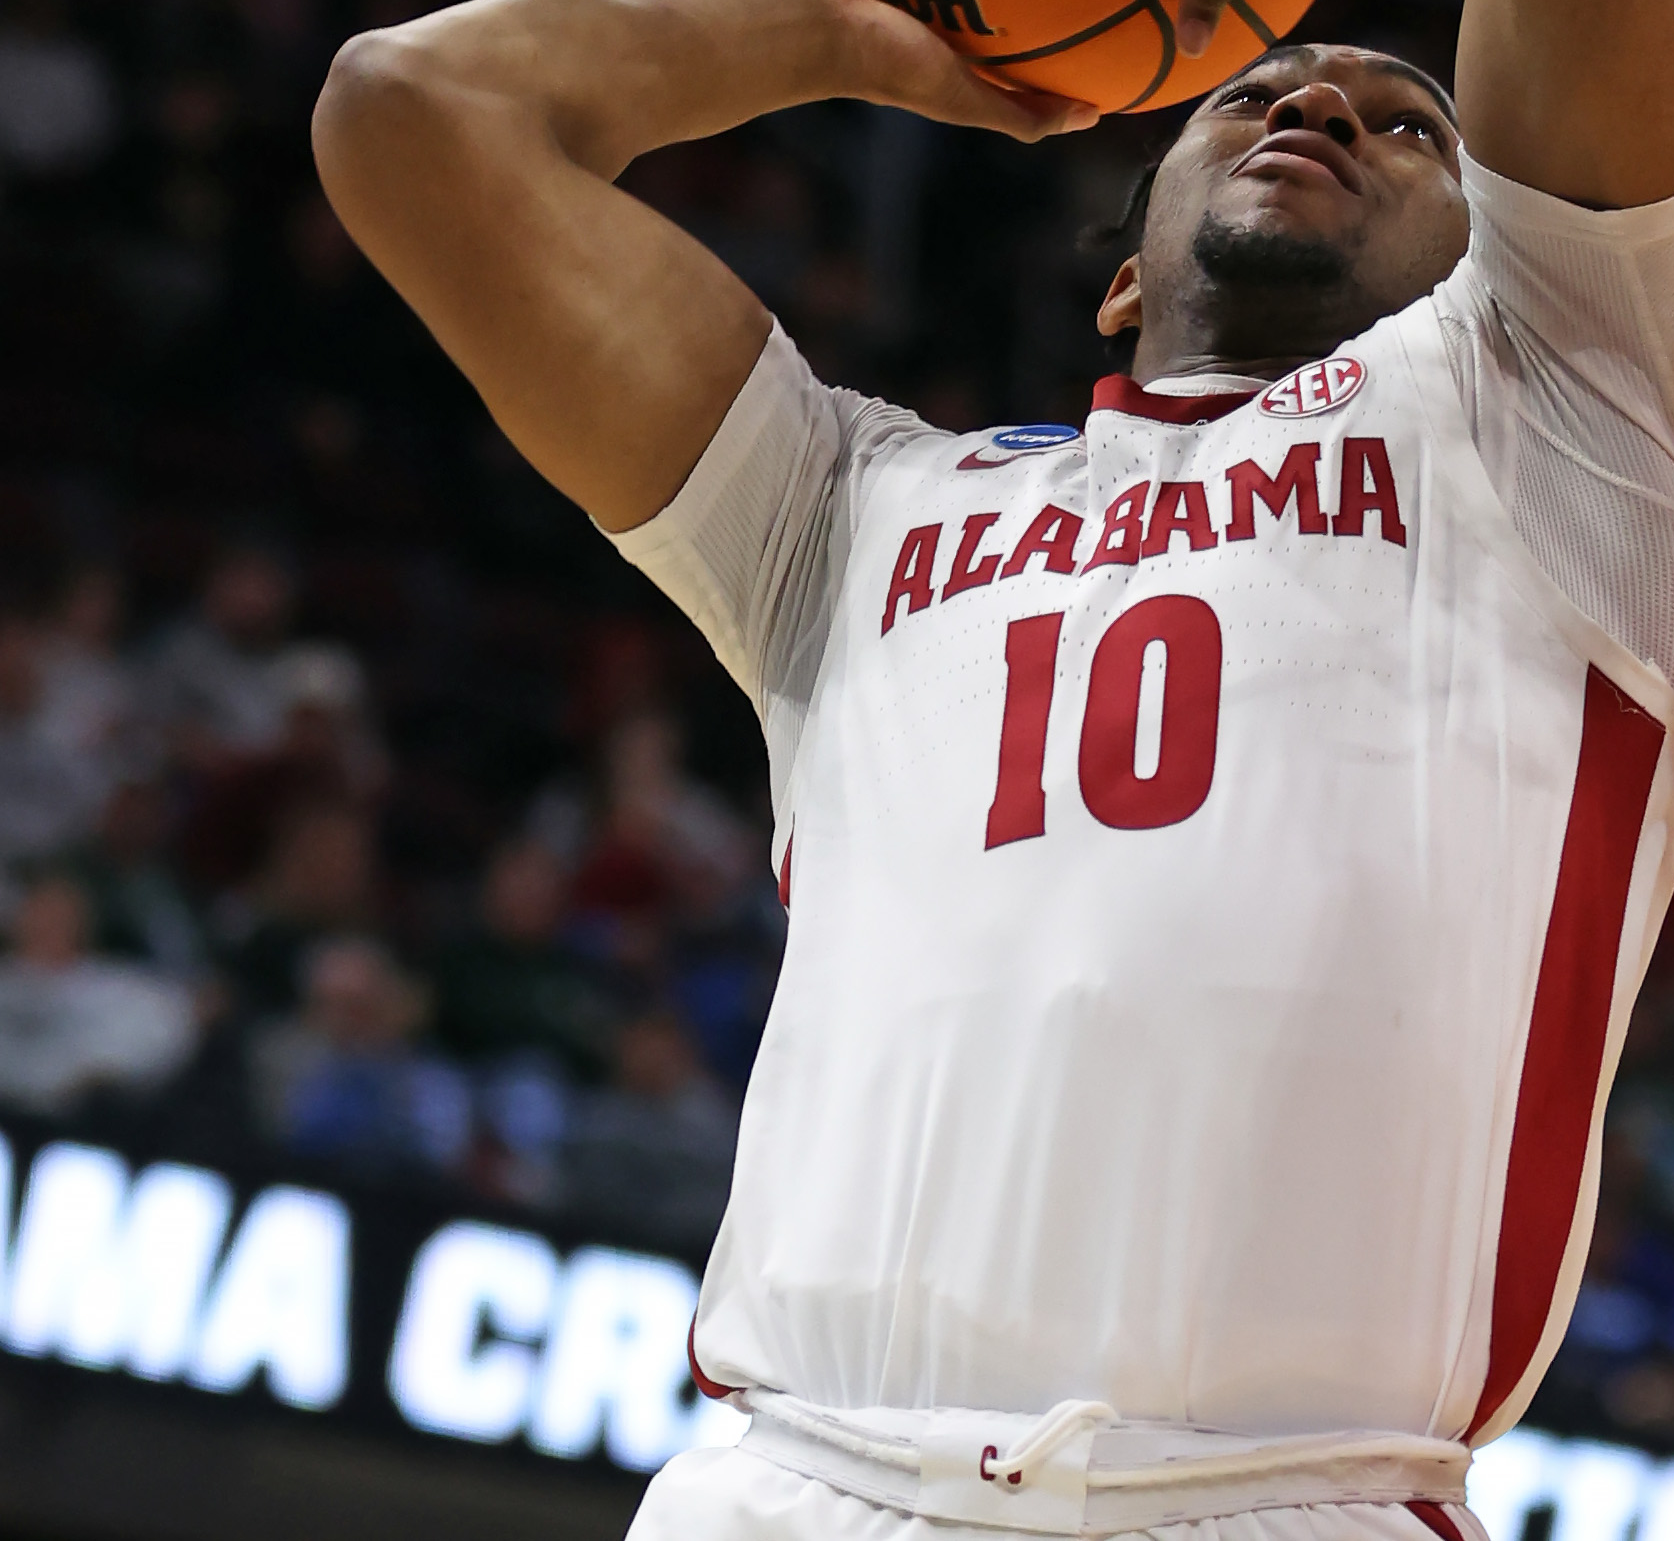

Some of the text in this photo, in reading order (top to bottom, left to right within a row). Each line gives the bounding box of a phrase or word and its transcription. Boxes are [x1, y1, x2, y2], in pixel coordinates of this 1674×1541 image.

[1266, 359, 1357, 414] SEC
[881, 436, 1407, 638] ALABAMA
[984, 593, 1223, 852] 10
[0, 1134, 750, 1469] MA CR
